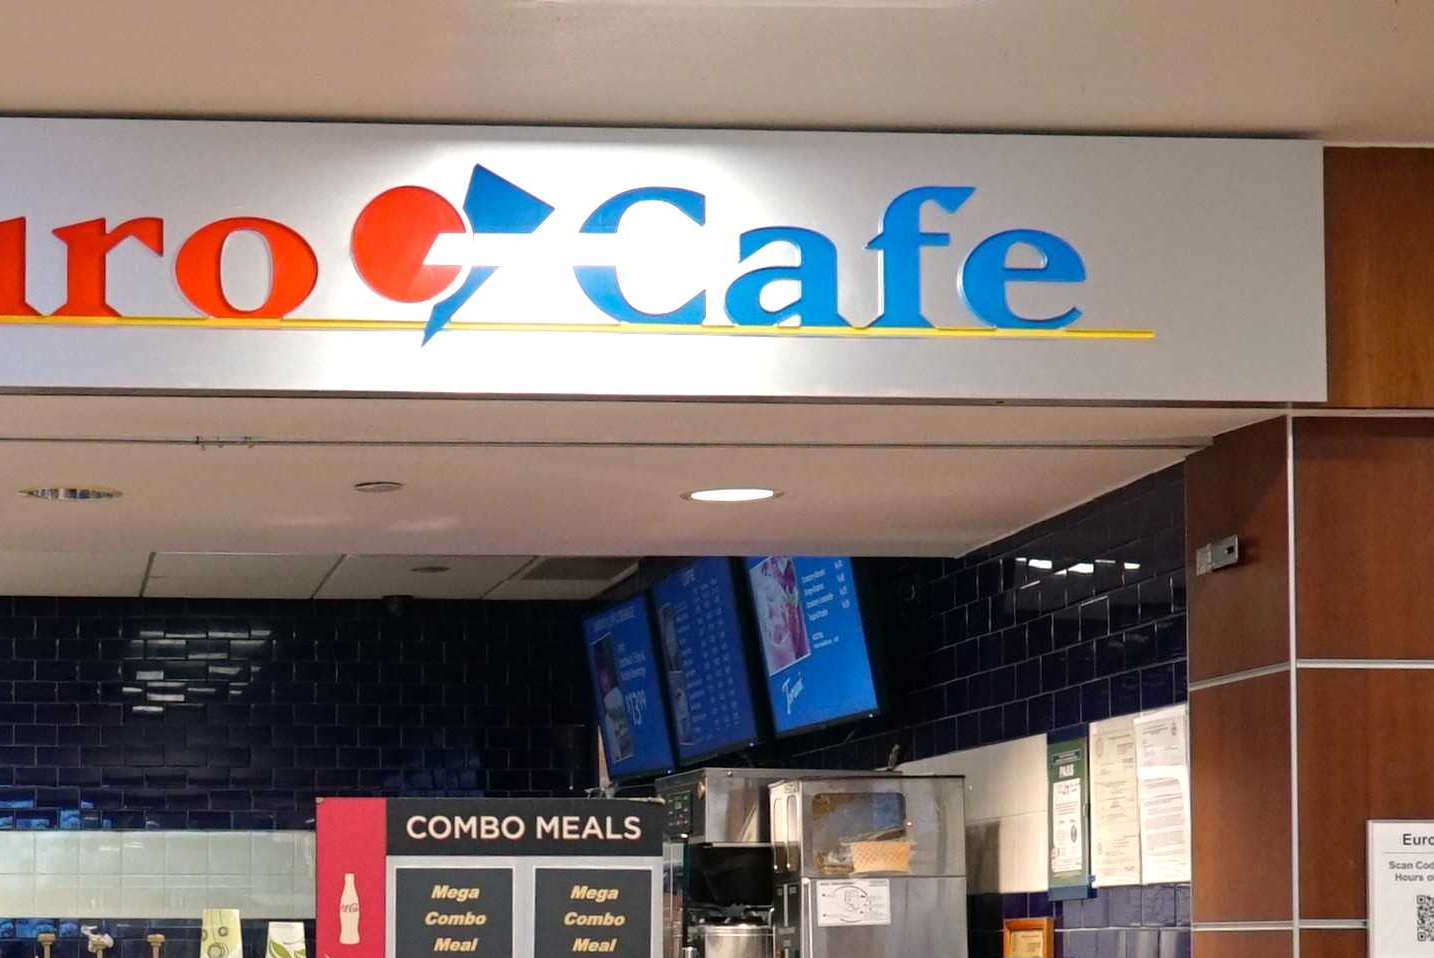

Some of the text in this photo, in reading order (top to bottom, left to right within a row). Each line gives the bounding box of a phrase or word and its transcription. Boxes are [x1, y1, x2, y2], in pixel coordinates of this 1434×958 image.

[576, 186, 1087, 330] Cafe
[1059, 764, 1074, 777] PASS
[406, 815, 642, 841] COMBO MEALS
[1402, 833, 1434, 846] Euro
[1389, 861, 1413, 870] Scan
[1395, 873, 1423, 882] Hours
[431, 884, 480, 902] Mega
[570, 885, 619, 903] Mega
[425, 911, 487, 925] Combo
[564, 911, 626, 926] Combo
[433, 937, 479, 952] Meal
[572, 938, 618, 952] Meal
